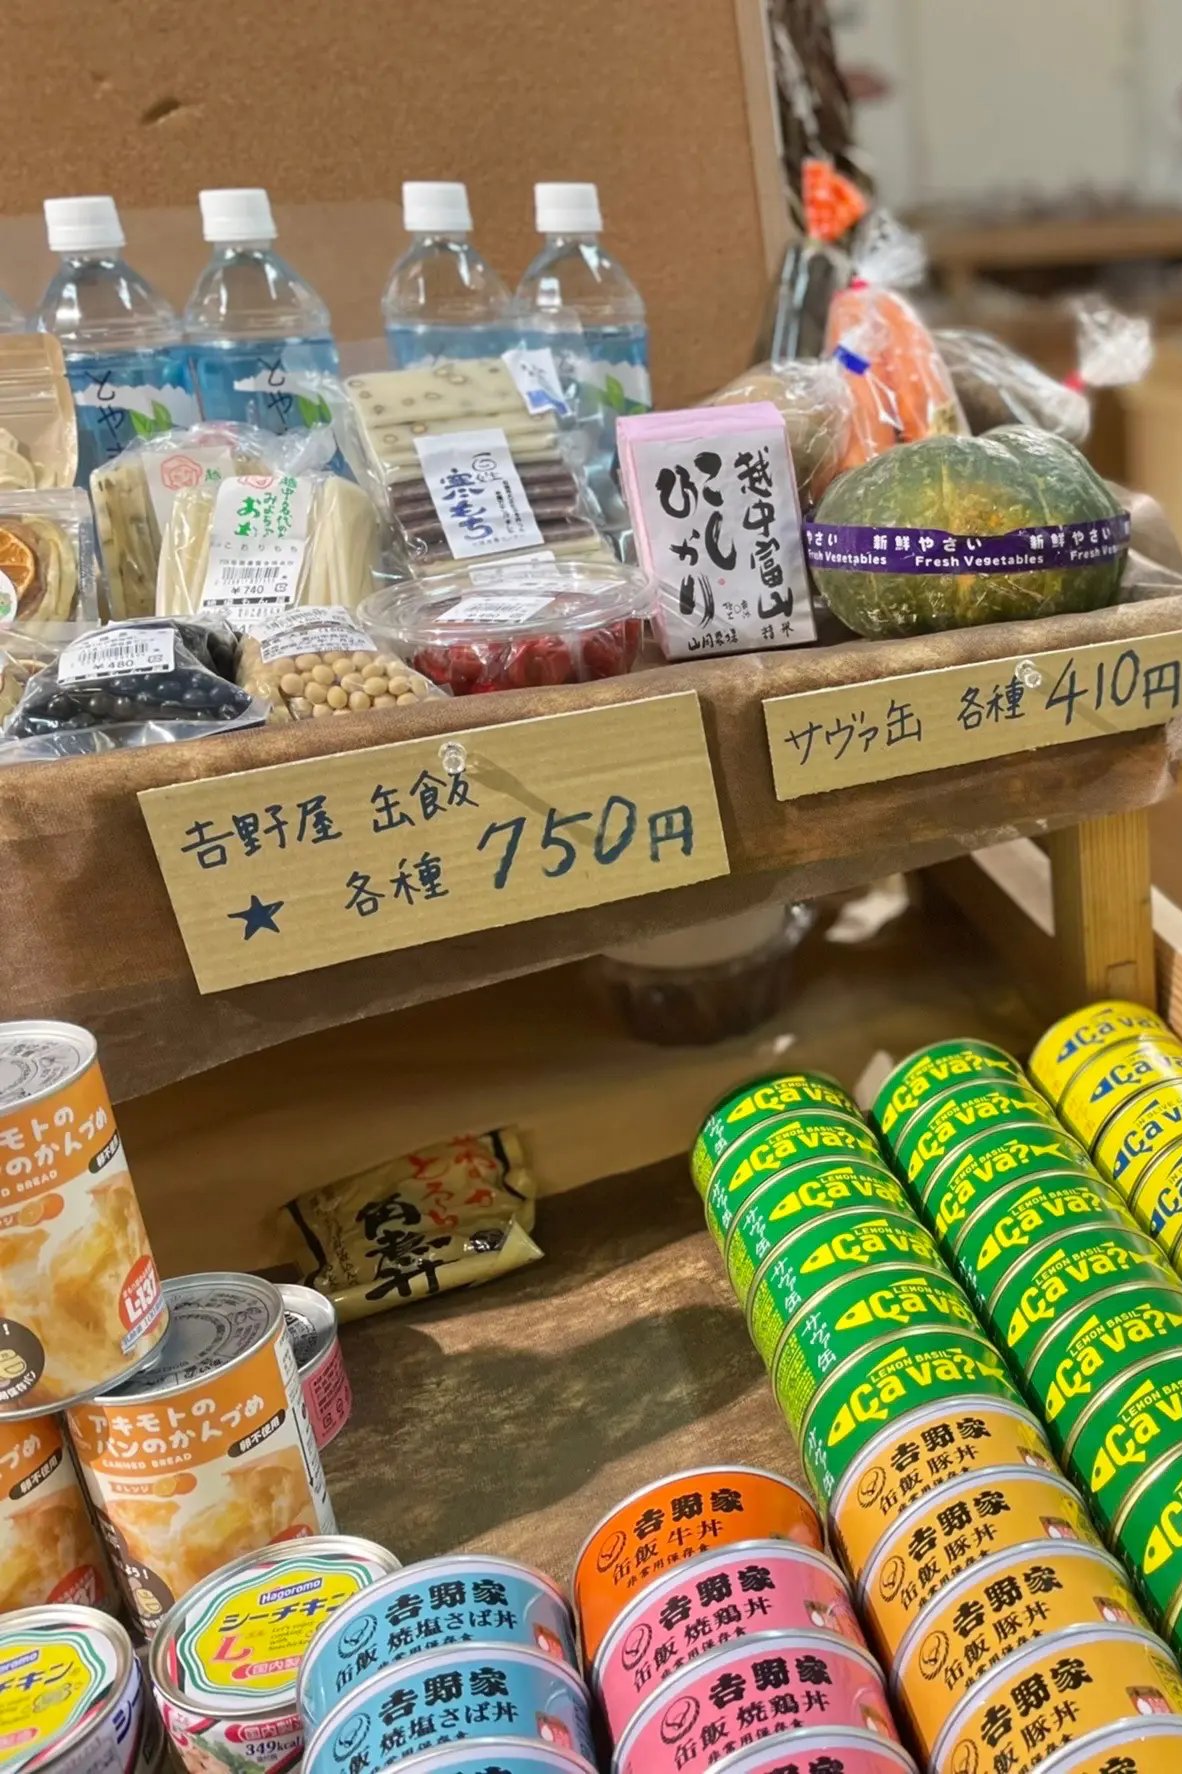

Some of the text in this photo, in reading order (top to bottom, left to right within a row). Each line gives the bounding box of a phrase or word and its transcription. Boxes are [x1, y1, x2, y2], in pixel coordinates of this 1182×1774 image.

[85, 370, 124, 459] とや
[440, 468, 493, 540] 寒もち
[824, 551, 887, 565] Vegetables
[873, 534, 982, 552] 新鮮やさい
[916, 554, 1044, 567] Fresh Vegetables
[1030, 527, 1111, 550] 新鮮やさい
[1070, 547, 1100, 561] Fresh
[784, 649, 1181, 764] サヴァ缶 各種 410円
[370, 770, 480, 833] 缶飯
[344, 794, 694, 917] 各種 750円
[769, 1129, 805, 1145] LEMON
[930, 1106, 960, 1130] LEMON
[16, 1170, 57, 1192] BREAD
[950, 1146, 1008, 1190] LEMON BASIL
[1011, 1195, 1048, 1216] LEMON
[1036, 1246, 1106, 1286] LEMON BASIL
[1070, 1310, 1141, 1357] LEMON BASIL
[870, 1350, 951, 1383] LEMON BASIL
[88, 1398, 216, 1436] アキモトの
[97, 1395, 265, 1458] パンのかんづめ
[1121, 1391, 1161, 1422] LEMON
[239, 1416, 280, 1453] 卵不使用
[890, 1417, 991, 1472] 吉野家
[152, 1454, 192, 1468] BREAD
[879, 1445, 979, 1516] 缶飯 豚丼
[633, 1488, 743, 1540] 吉野家
[908, 1490, 1011, 1562] 吉野家
[613, 1519, 724, 1585] 缶飯 牛丼
[900, 1524, 998, 1610] 缶飯 豚丼
[261, 1578, 321, 1604] Hagoromo
[385, 1579, 509, 1626] 吉野家
[659, 1565, 775, 1631] 吉野家
[953, 1566, 1063, 1638] 吉野家
[387, 1609, 517, 1654] 焼塩さば丼
[633, 1596, 773, 1693] 缶飯 焼鶏丼
[944, 1601, 1051, 1691] 缶飯 豚丼
[379, 1667, 509, 1725] 吉野家
[709, 1655, 833, 1710] 吉野家
[981, 1658, 1093, 1748] 吉野家
[673, 1690, 830, 1771] 缶飯 焼鶏丼
[1020, 1700, 1080, 1751] 豚丼
